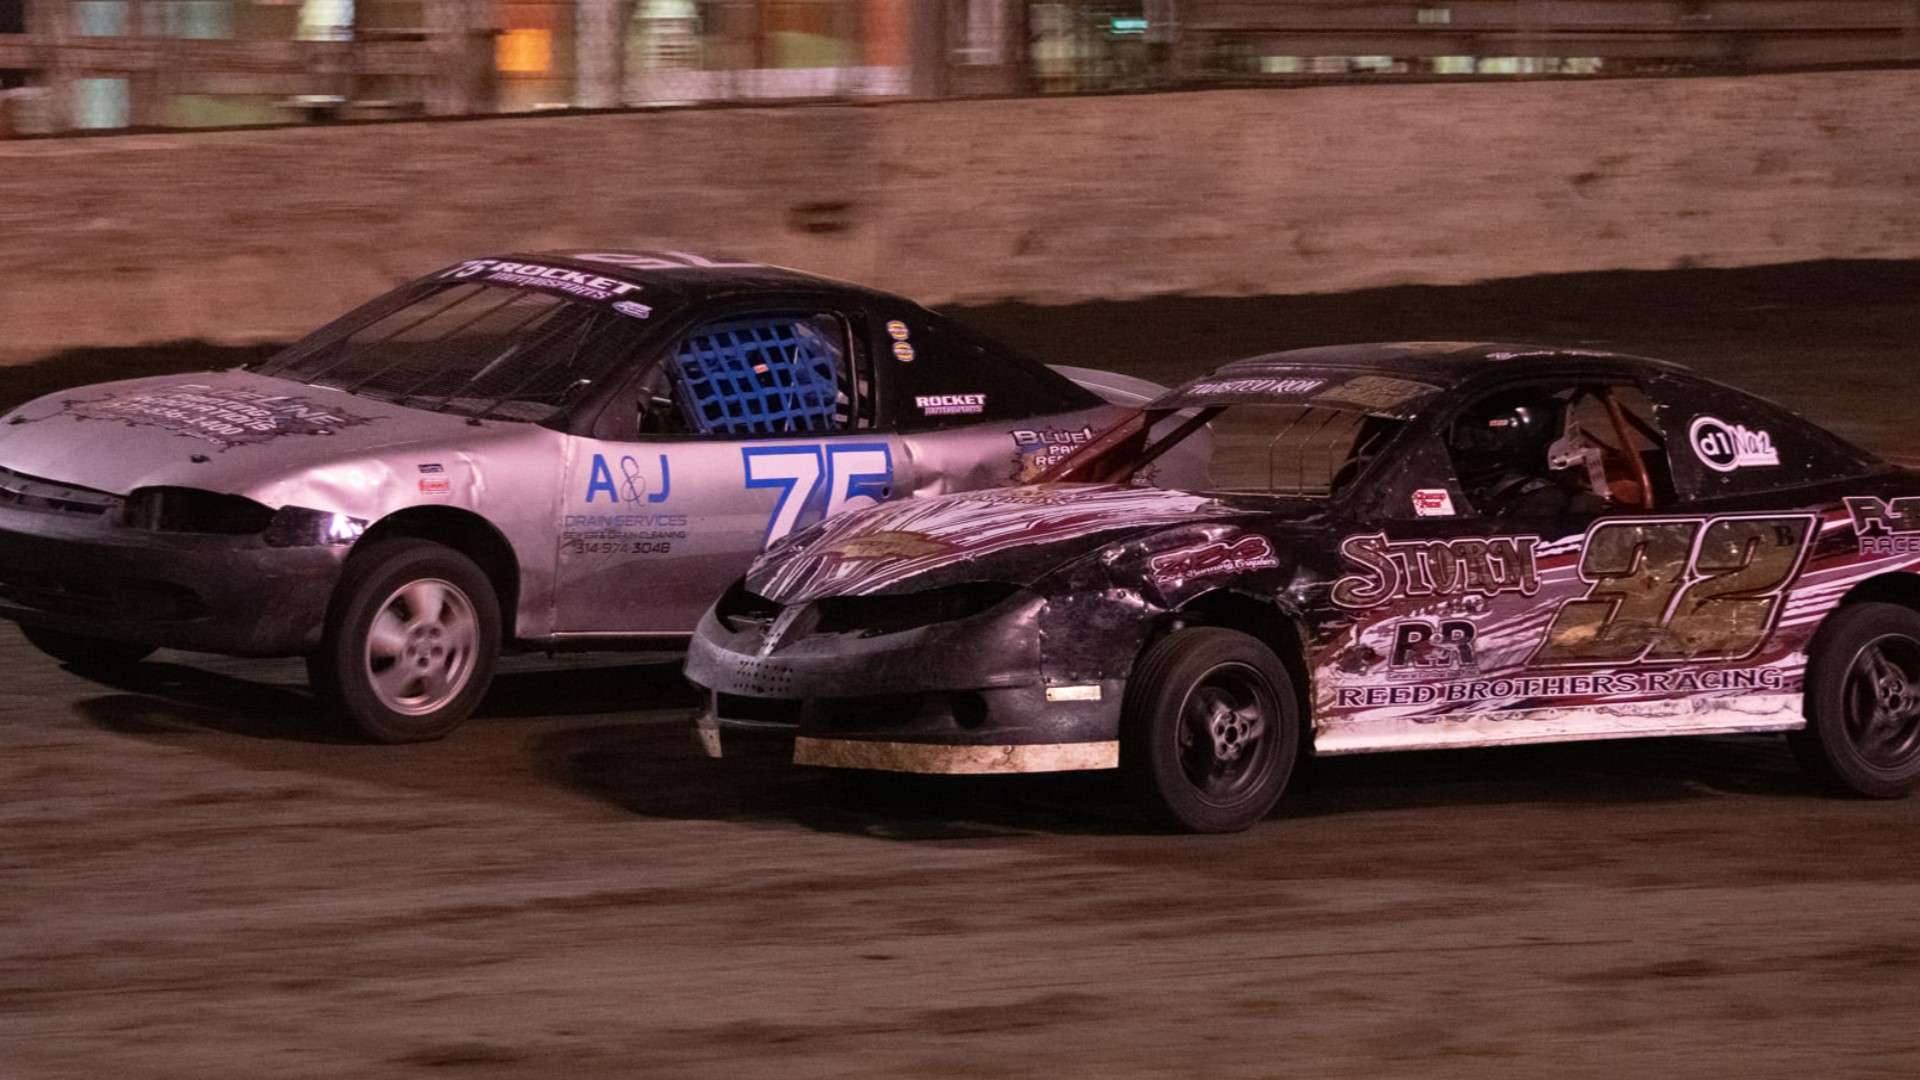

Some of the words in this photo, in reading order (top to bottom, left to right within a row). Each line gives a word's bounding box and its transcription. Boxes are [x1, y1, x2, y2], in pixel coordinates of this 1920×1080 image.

[488, 261, 641, 295] ROCKET
[915, 393, 987, 408] ROCKET
[586, 454, 619, 503] A
[648, 454, 672, 503] J
[741, 443, 894, 550] 75
[614, 515, 688, 527] SERVICES
[1335, 685, 1439, 708] REED
[1442, 672, 1638, 702] BROTHERS
[1645, 666, 1784, 692] RACING
